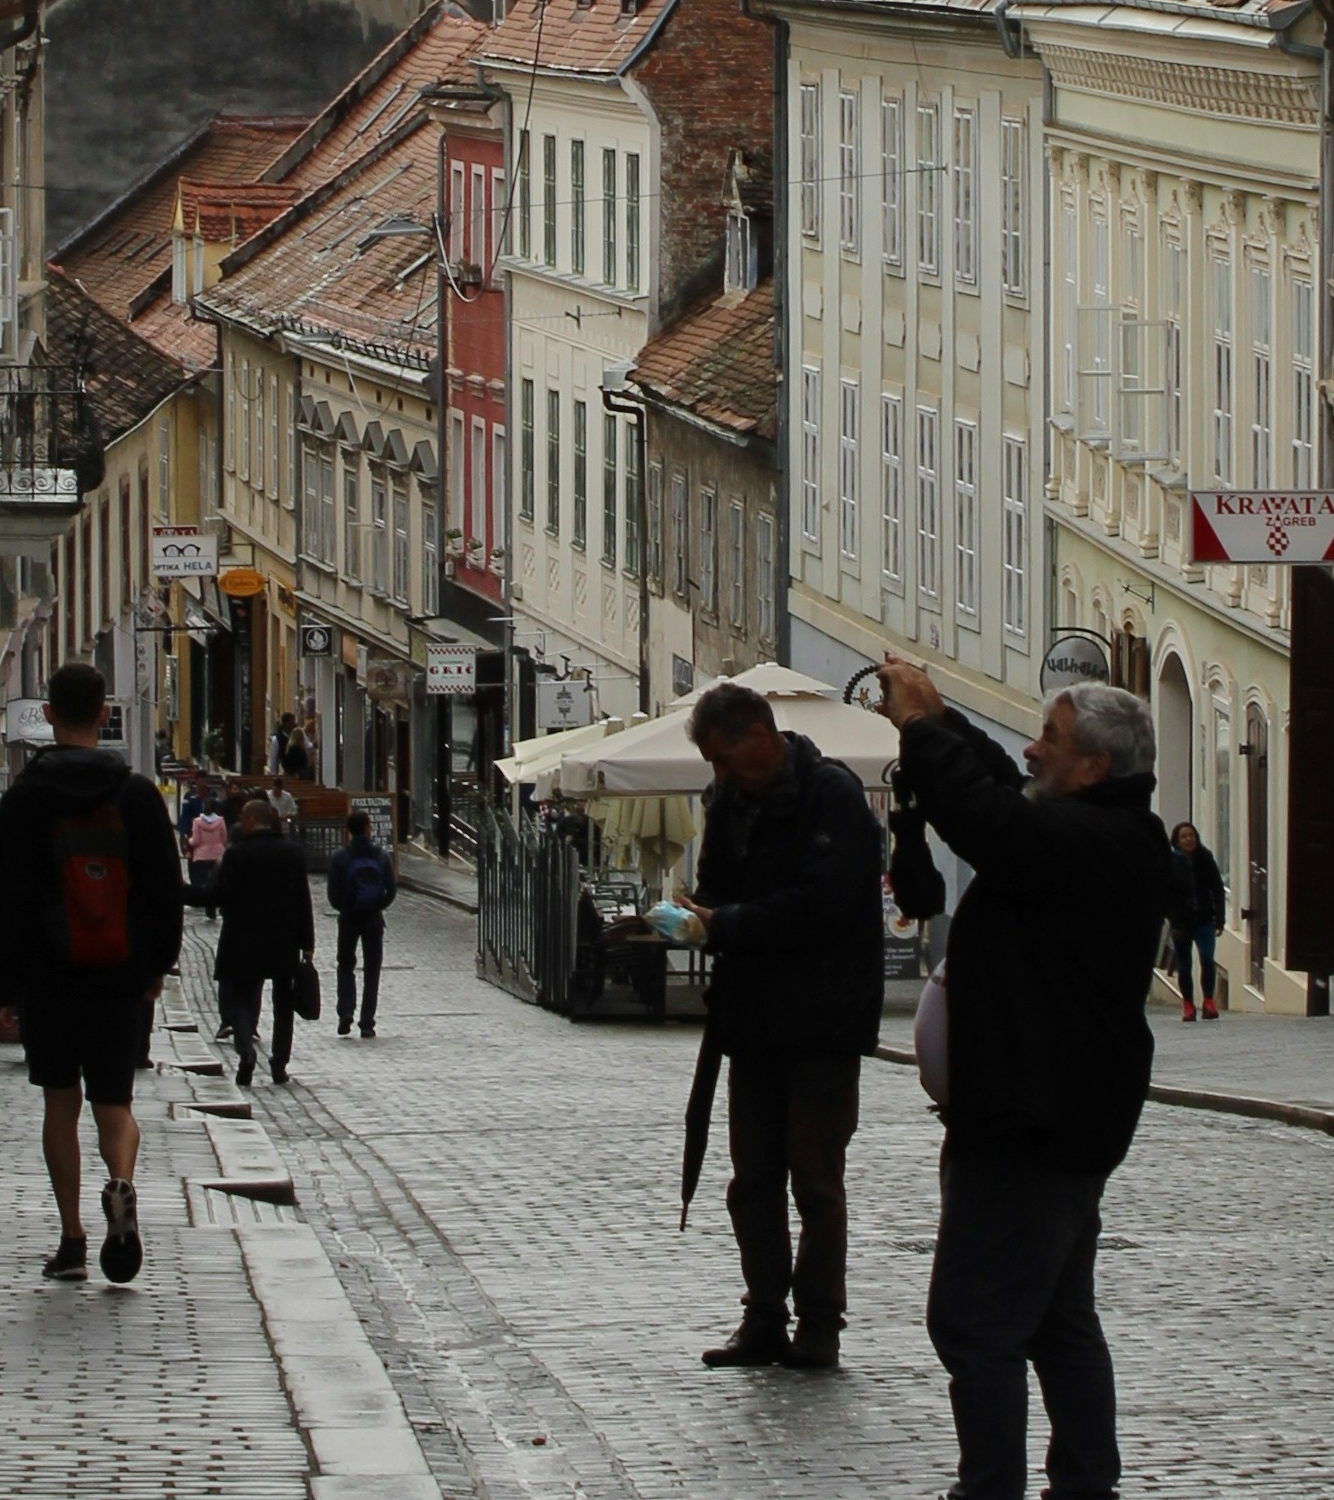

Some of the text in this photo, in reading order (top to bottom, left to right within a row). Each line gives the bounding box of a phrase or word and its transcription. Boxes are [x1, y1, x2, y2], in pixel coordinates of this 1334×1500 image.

[1265, 515, 1317, 527] ZAGREB
[183, 561, 213, 571] HELA
[429, 663, 474, 675] GRIČ
